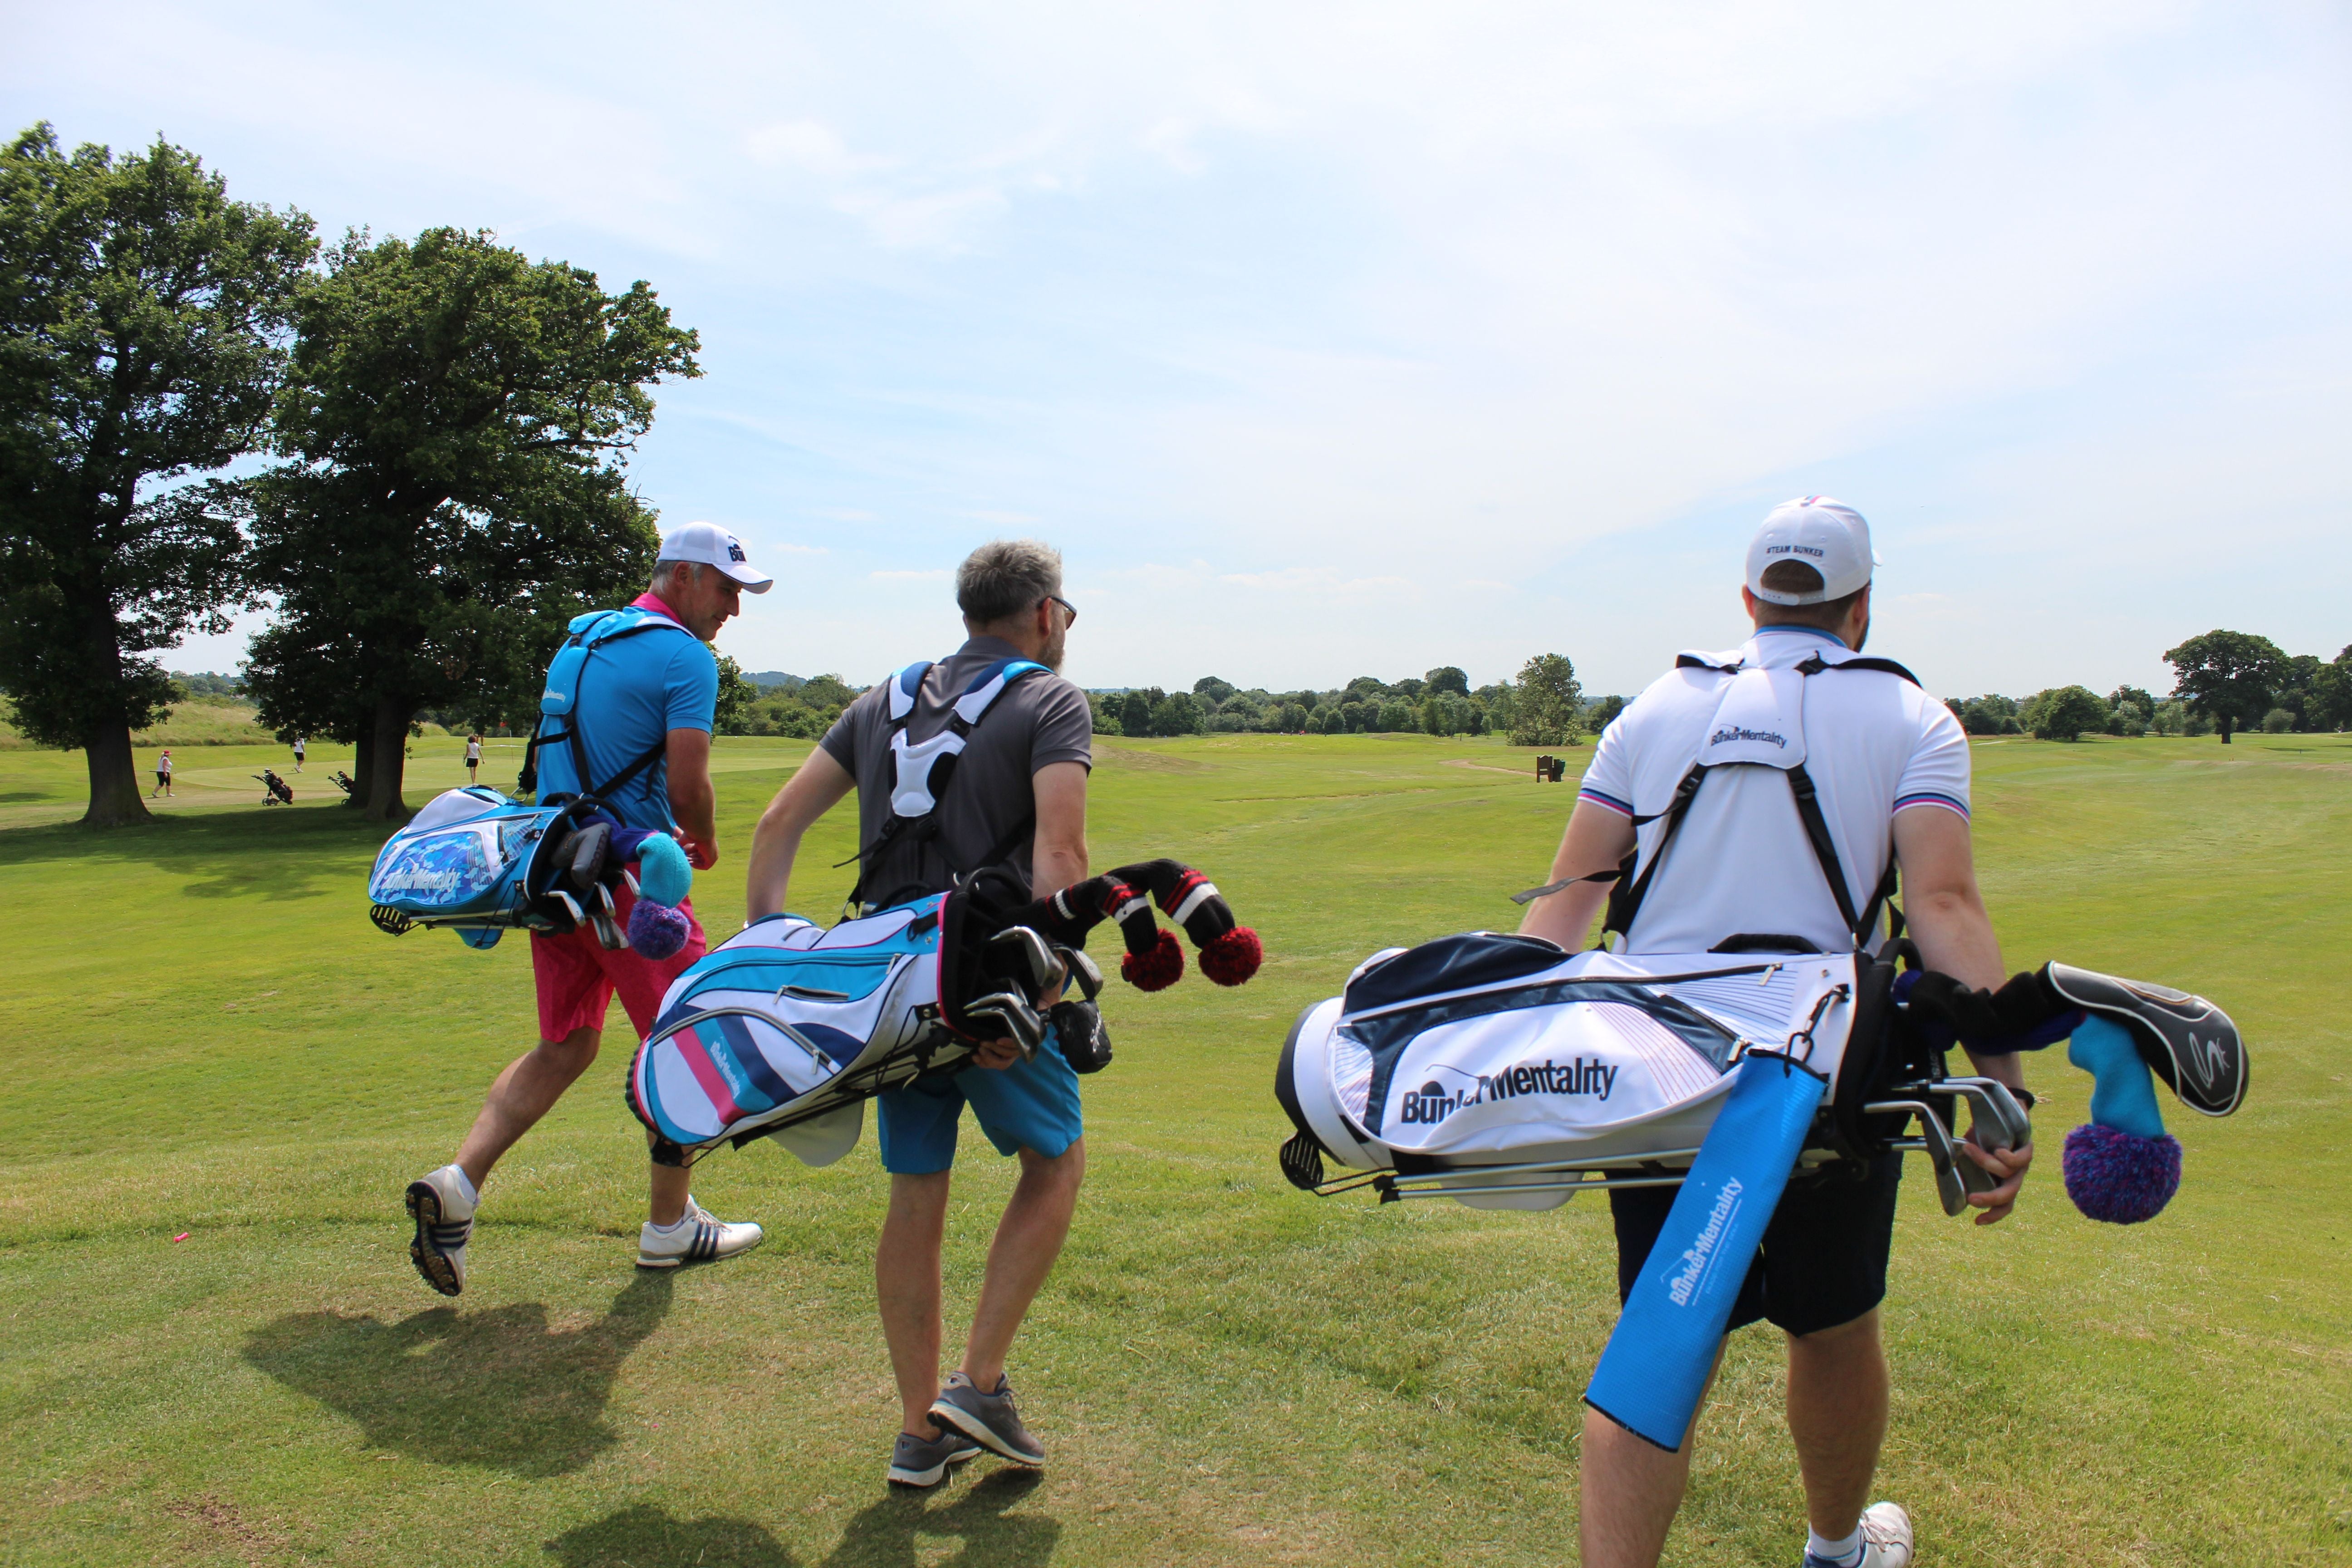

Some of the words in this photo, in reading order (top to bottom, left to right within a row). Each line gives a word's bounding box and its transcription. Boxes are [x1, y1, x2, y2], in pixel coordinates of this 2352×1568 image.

[1766, 545, 1790, 554] #TEAM
[1793, 545, 1823, 558] BUNKER
[1668, 1176, 1743, 1307] BunkerMentality
